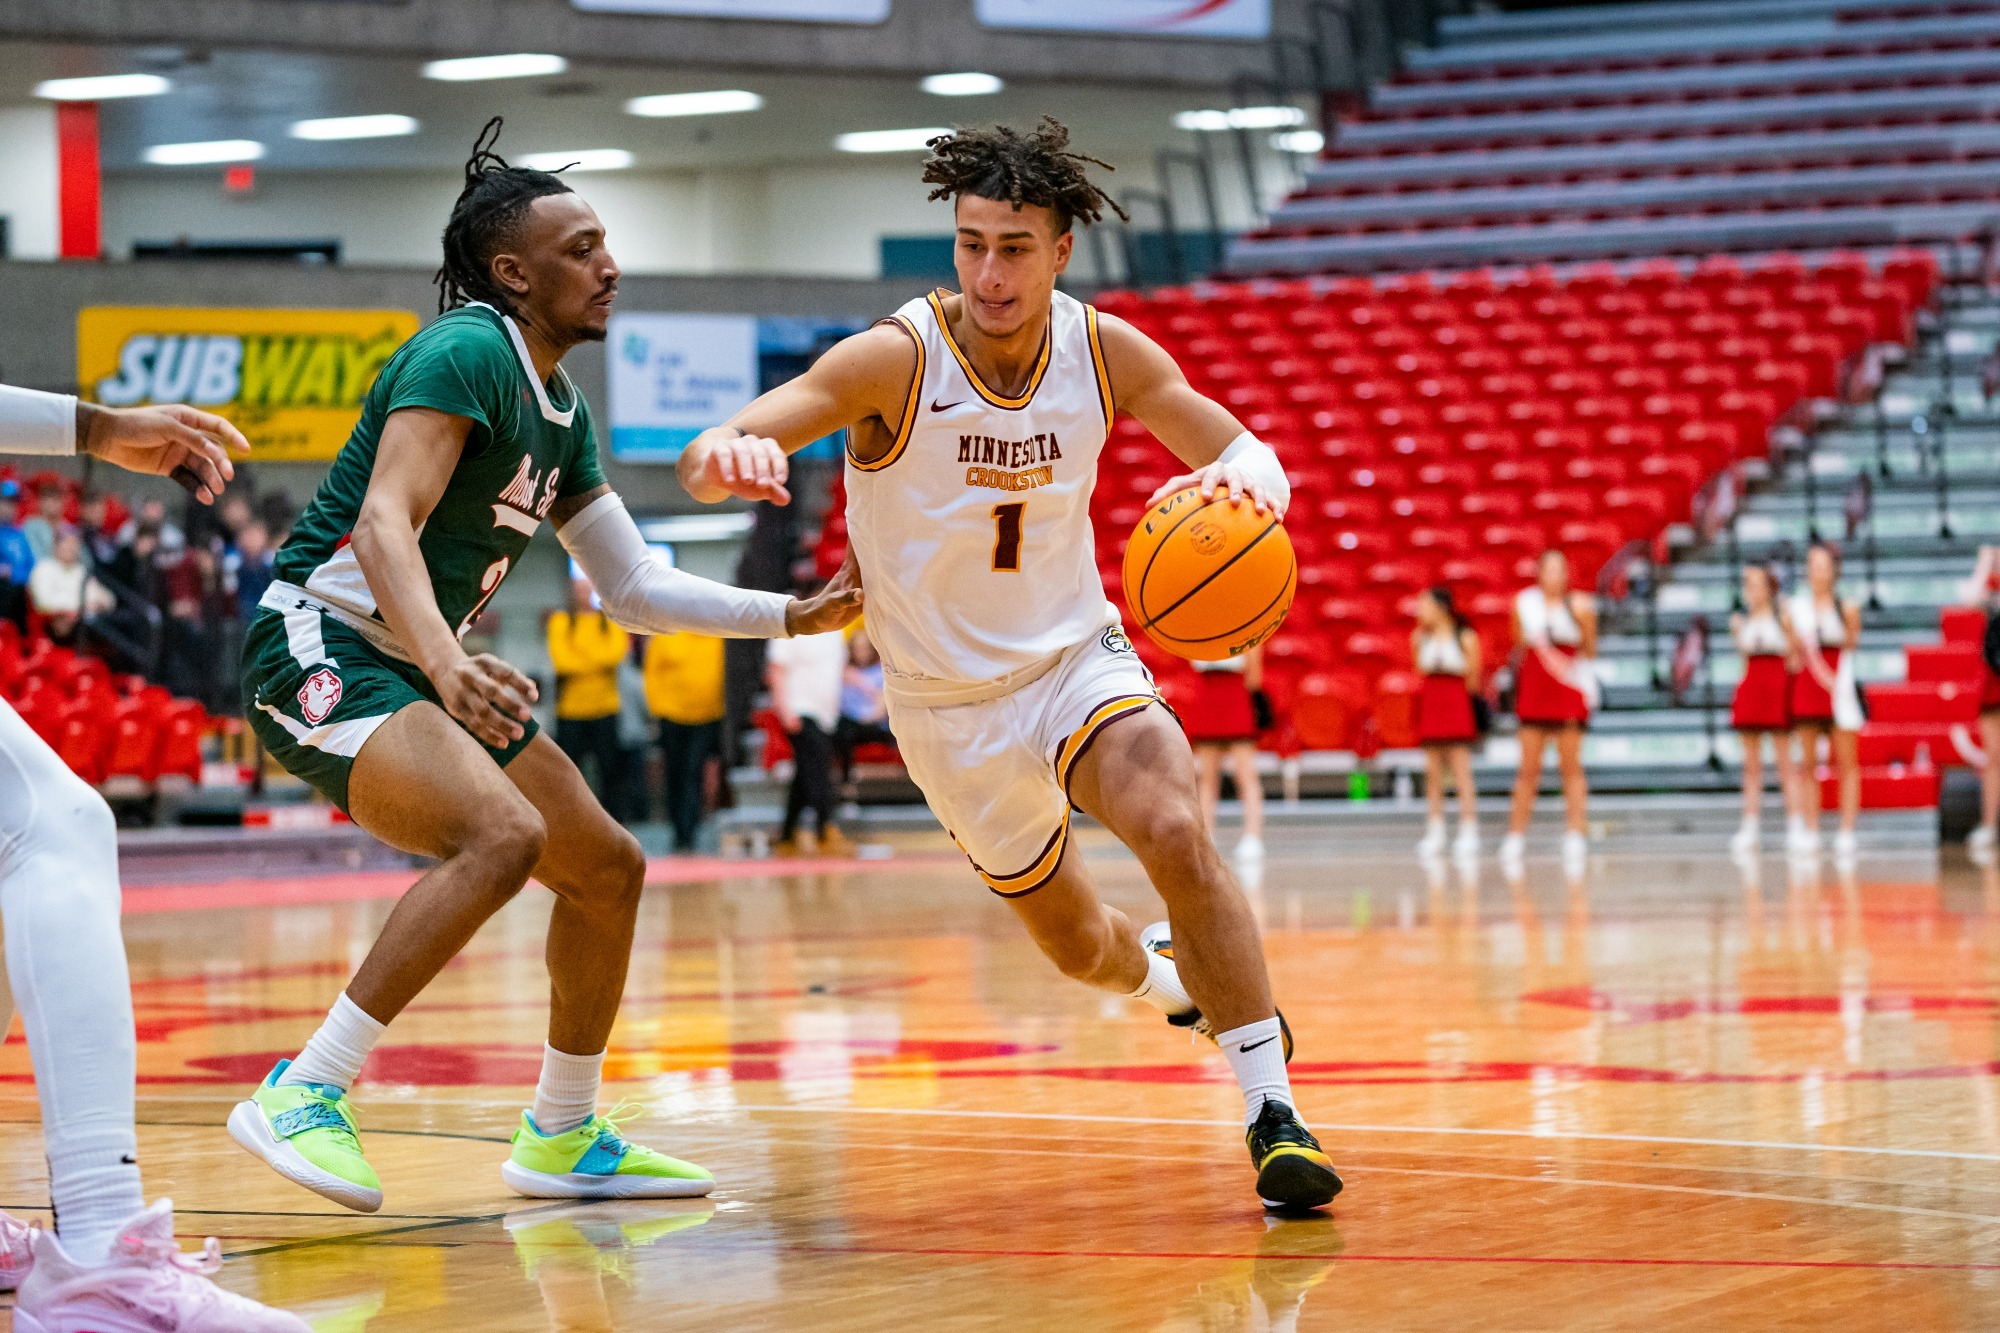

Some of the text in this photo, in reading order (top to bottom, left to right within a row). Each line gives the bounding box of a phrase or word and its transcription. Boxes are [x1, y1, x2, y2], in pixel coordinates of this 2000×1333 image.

[97, 325, 403, 406] SUBWAY
[957, 432, 1063, 469] MINNESOTA
[966, 465, 1054, 492] CROOKSTON
[990, 501, 1028, 573] 1
